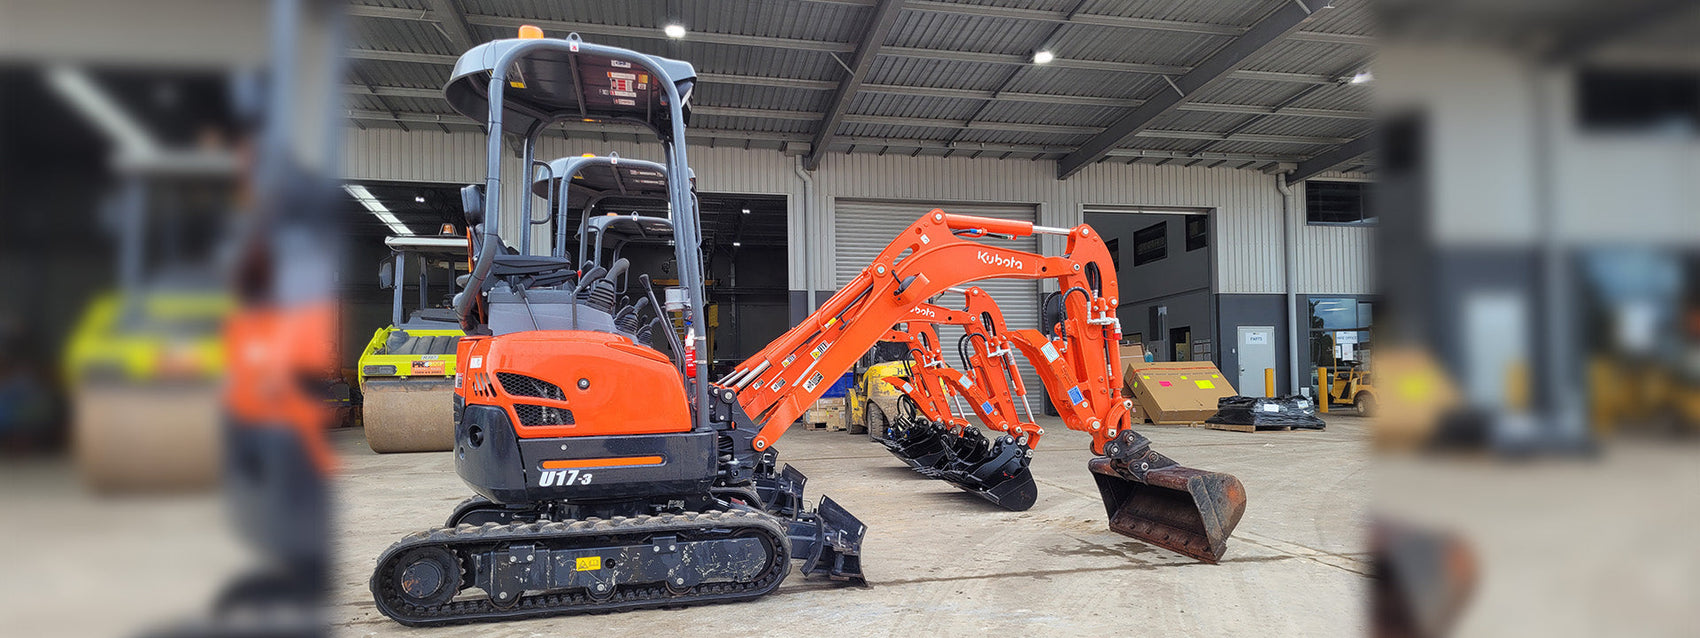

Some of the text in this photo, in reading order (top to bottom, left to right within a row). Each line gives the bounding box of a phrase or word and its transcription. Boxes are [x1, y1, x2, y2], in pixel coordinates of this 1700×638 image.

[977, 250, 1023, 270] Kubota
[910, 306, 935, 318] bota
[538, 469, 593, 487] U17-3
